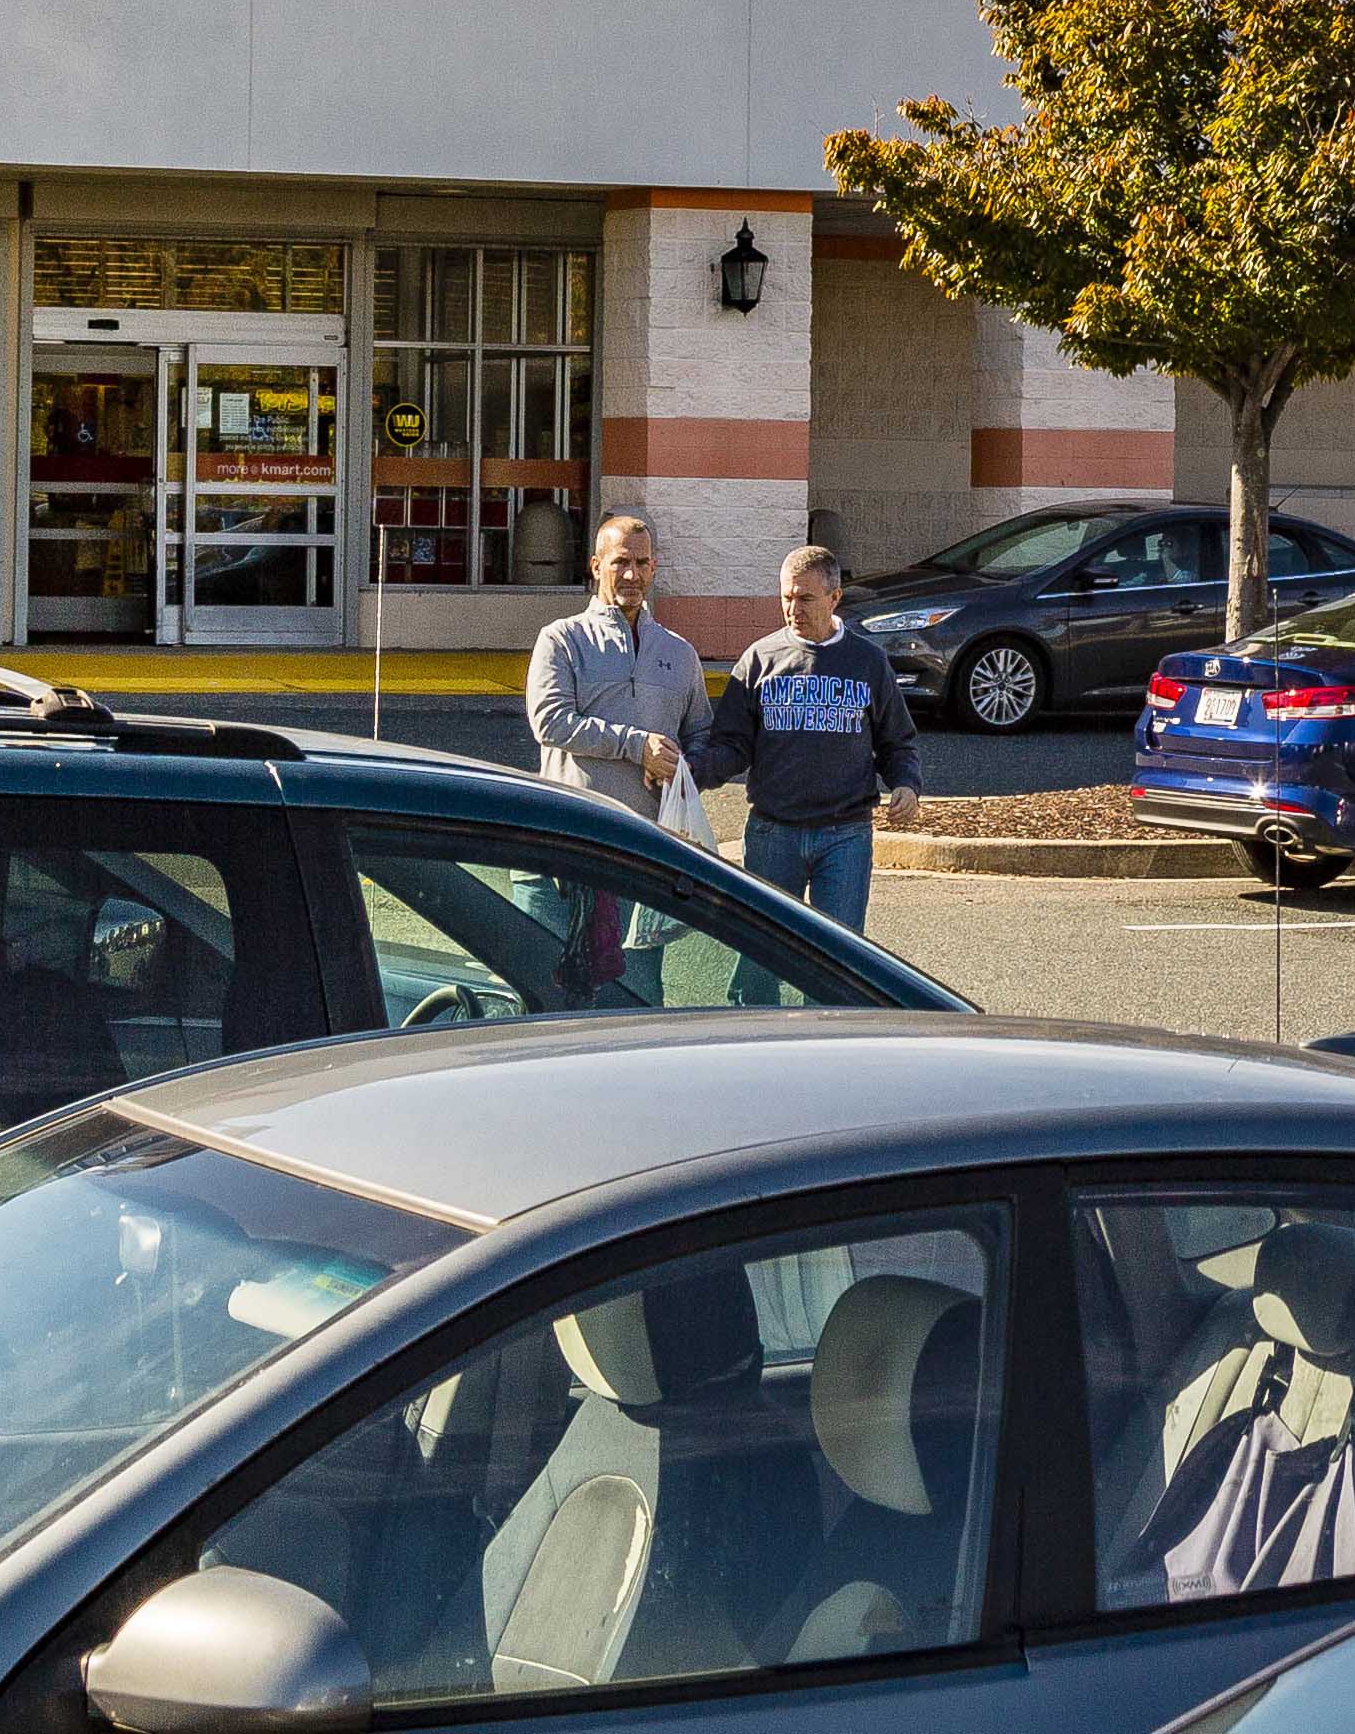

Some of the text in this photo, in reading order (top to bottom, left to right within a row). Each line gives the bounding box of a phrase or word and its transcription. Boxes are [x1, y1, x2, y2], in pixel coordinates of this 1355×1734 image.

[216, 465, 249, 475] more
[261, 463, 332, 476] kmart.com
[761, 675, 871, 708] AMERICAN
[763, 706, 865, 733] UNIVERSITY
